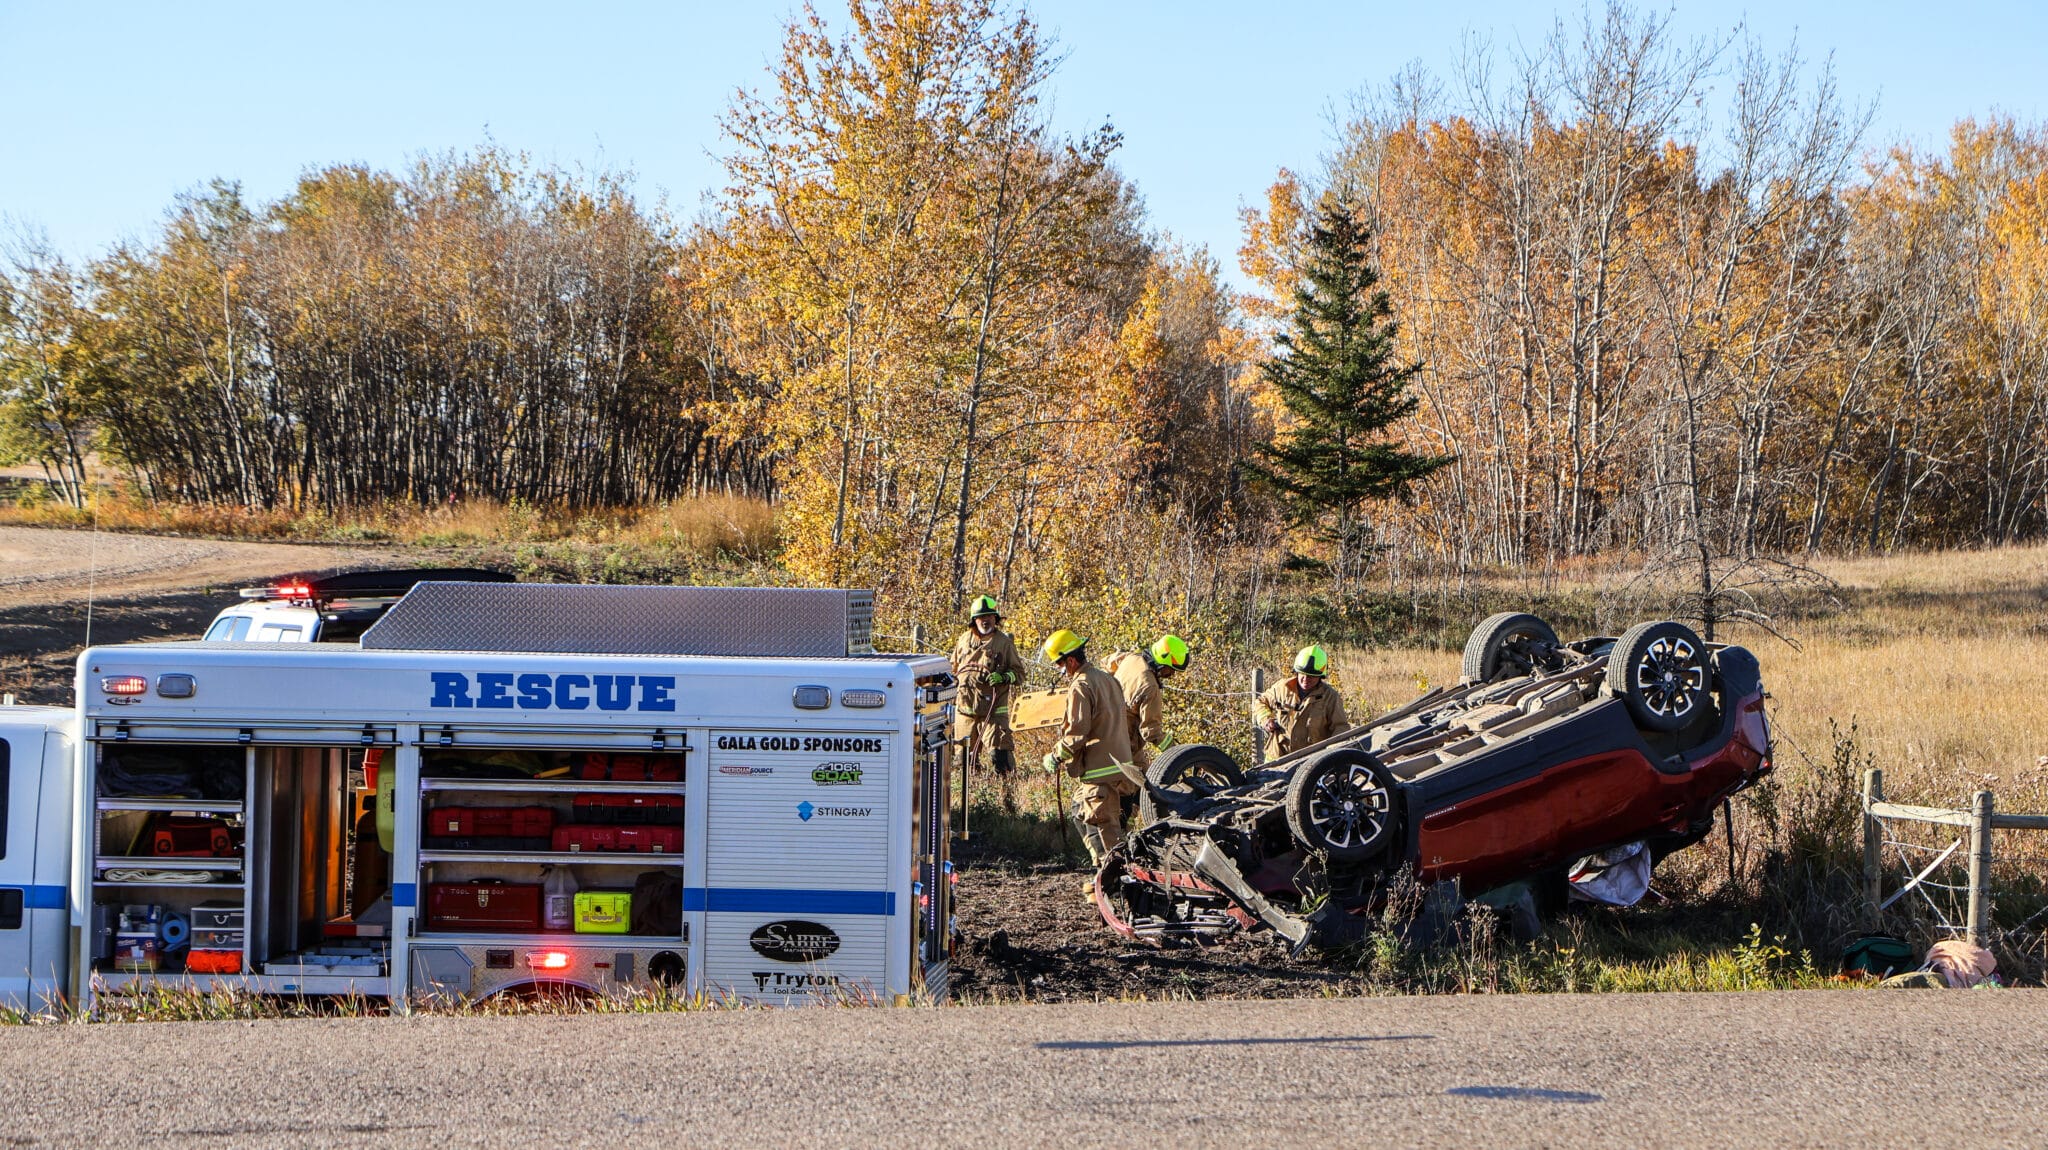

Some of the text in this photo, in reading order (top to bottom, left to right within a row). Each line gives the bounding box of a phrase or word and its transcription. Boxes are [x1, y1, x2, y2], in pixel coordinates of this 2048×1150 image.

[431, 672, 676, 711] RESCUE
[717, 736, 882, 753] GALA GOLD SPONSORS
[812, 770, 863, 781] GOAT
[817, 807, 872, 817] STINGRAY
[765, 924, 832, 949] SABRE
[773, 972, 839, 987] Tryton
